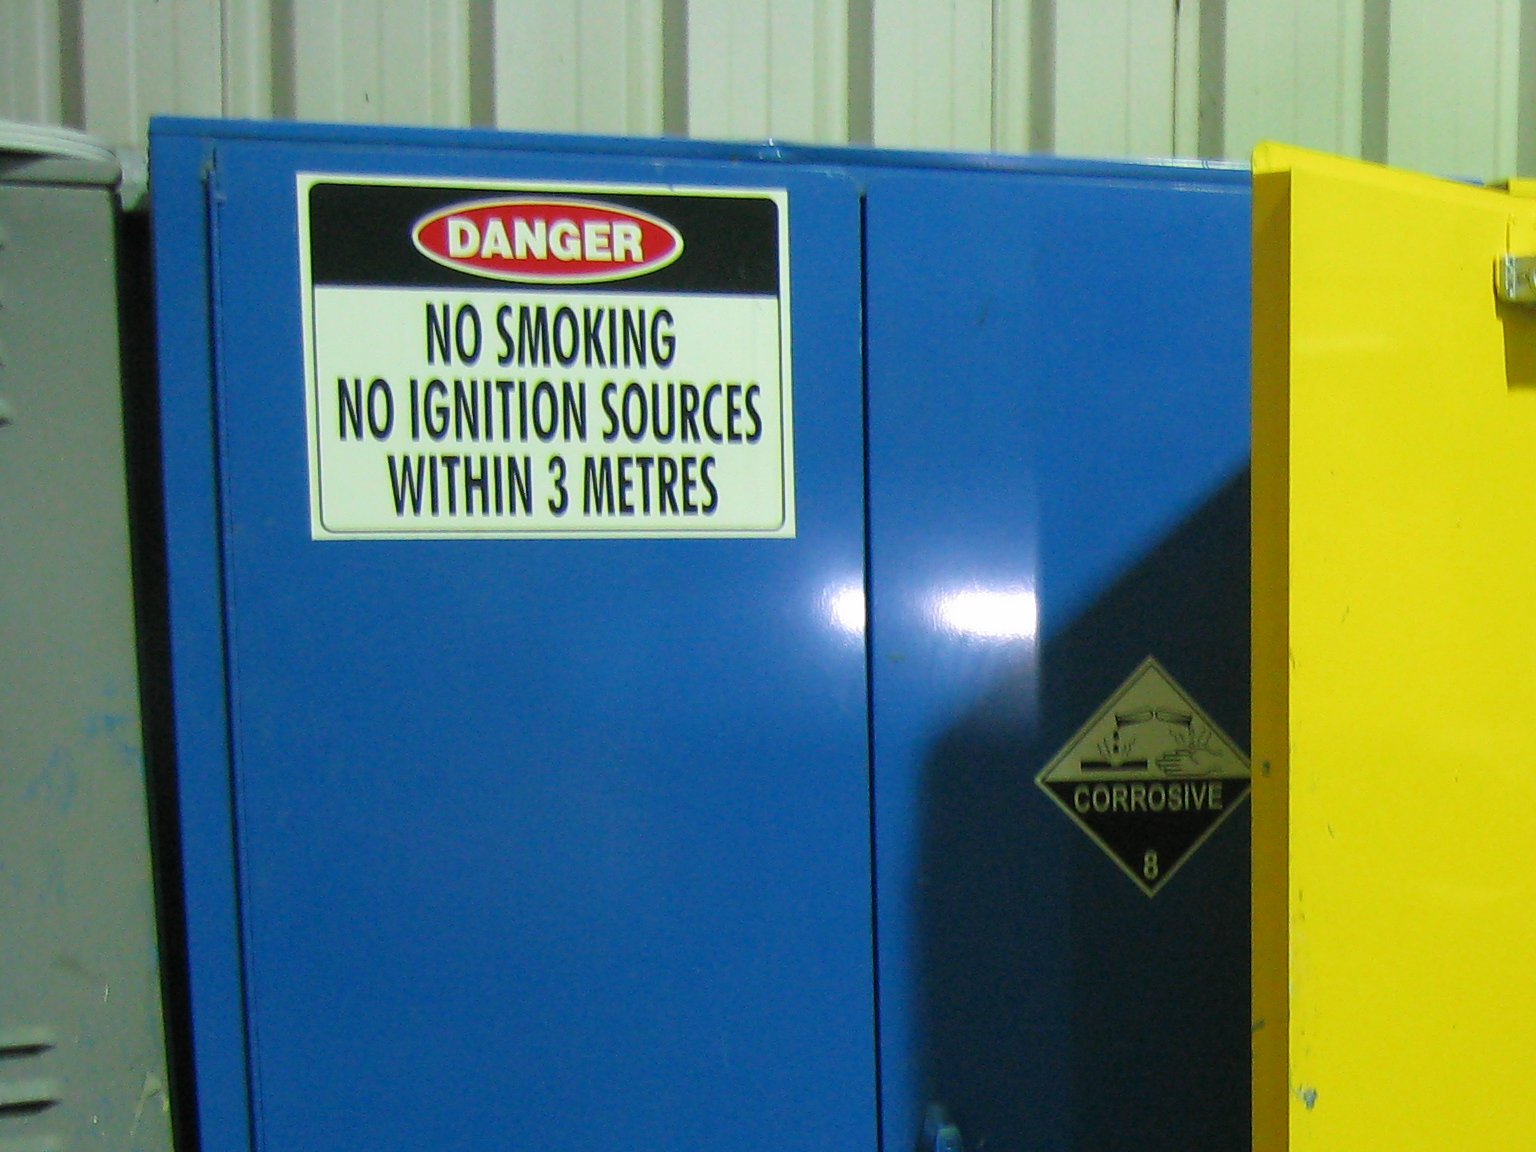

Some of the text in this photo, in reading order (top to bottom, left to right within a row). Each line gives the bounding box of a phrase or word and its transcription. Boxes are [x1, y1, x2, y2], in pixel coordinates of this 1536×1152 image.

[447, 217, 645, 264] DANGER
[425, 301, 677, 369] NO SMOKING
[337, 377, 763, 445] NO IGNITION SOURCES
[387, 453, 720, 518] WITHIN 3 METRES
[1073, 782, 1224, 814] CORROSIVE
[1142, 849, 1160, 881] 8
